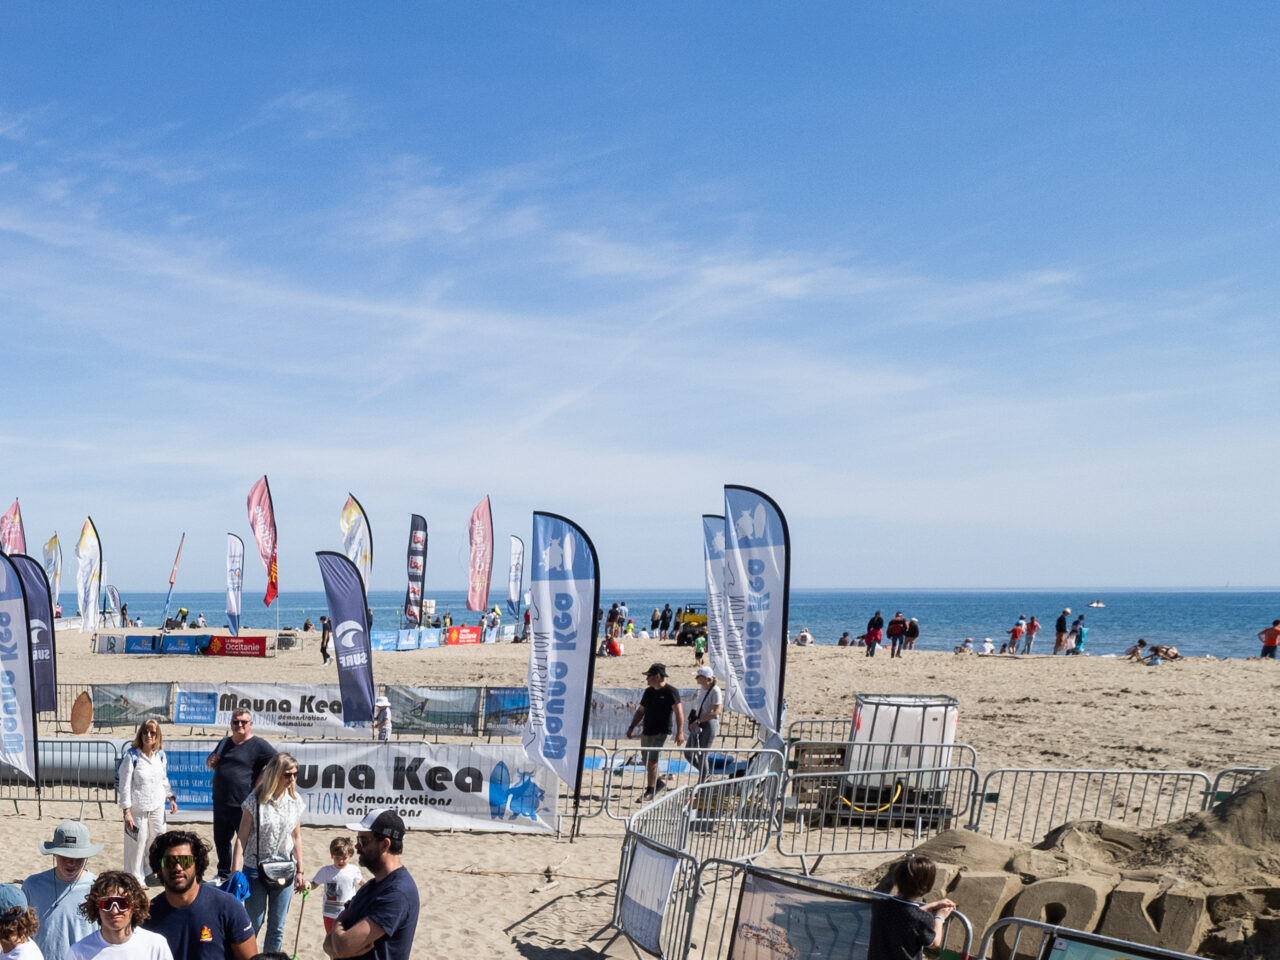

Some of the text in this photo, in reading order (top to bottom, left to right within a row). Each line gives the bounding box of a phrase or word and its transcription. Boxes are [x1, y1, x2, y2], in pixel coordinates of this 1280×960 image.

[225, 642, 260, 651] Occitanie
[220, 694, 292, 713] Mauna
[300, 695, 343, 714] Kea
[296, 756, 483, 793] una Kea
[347, 793, 452, 806] démonstrations
[347, 805, 422, 817] aniions
